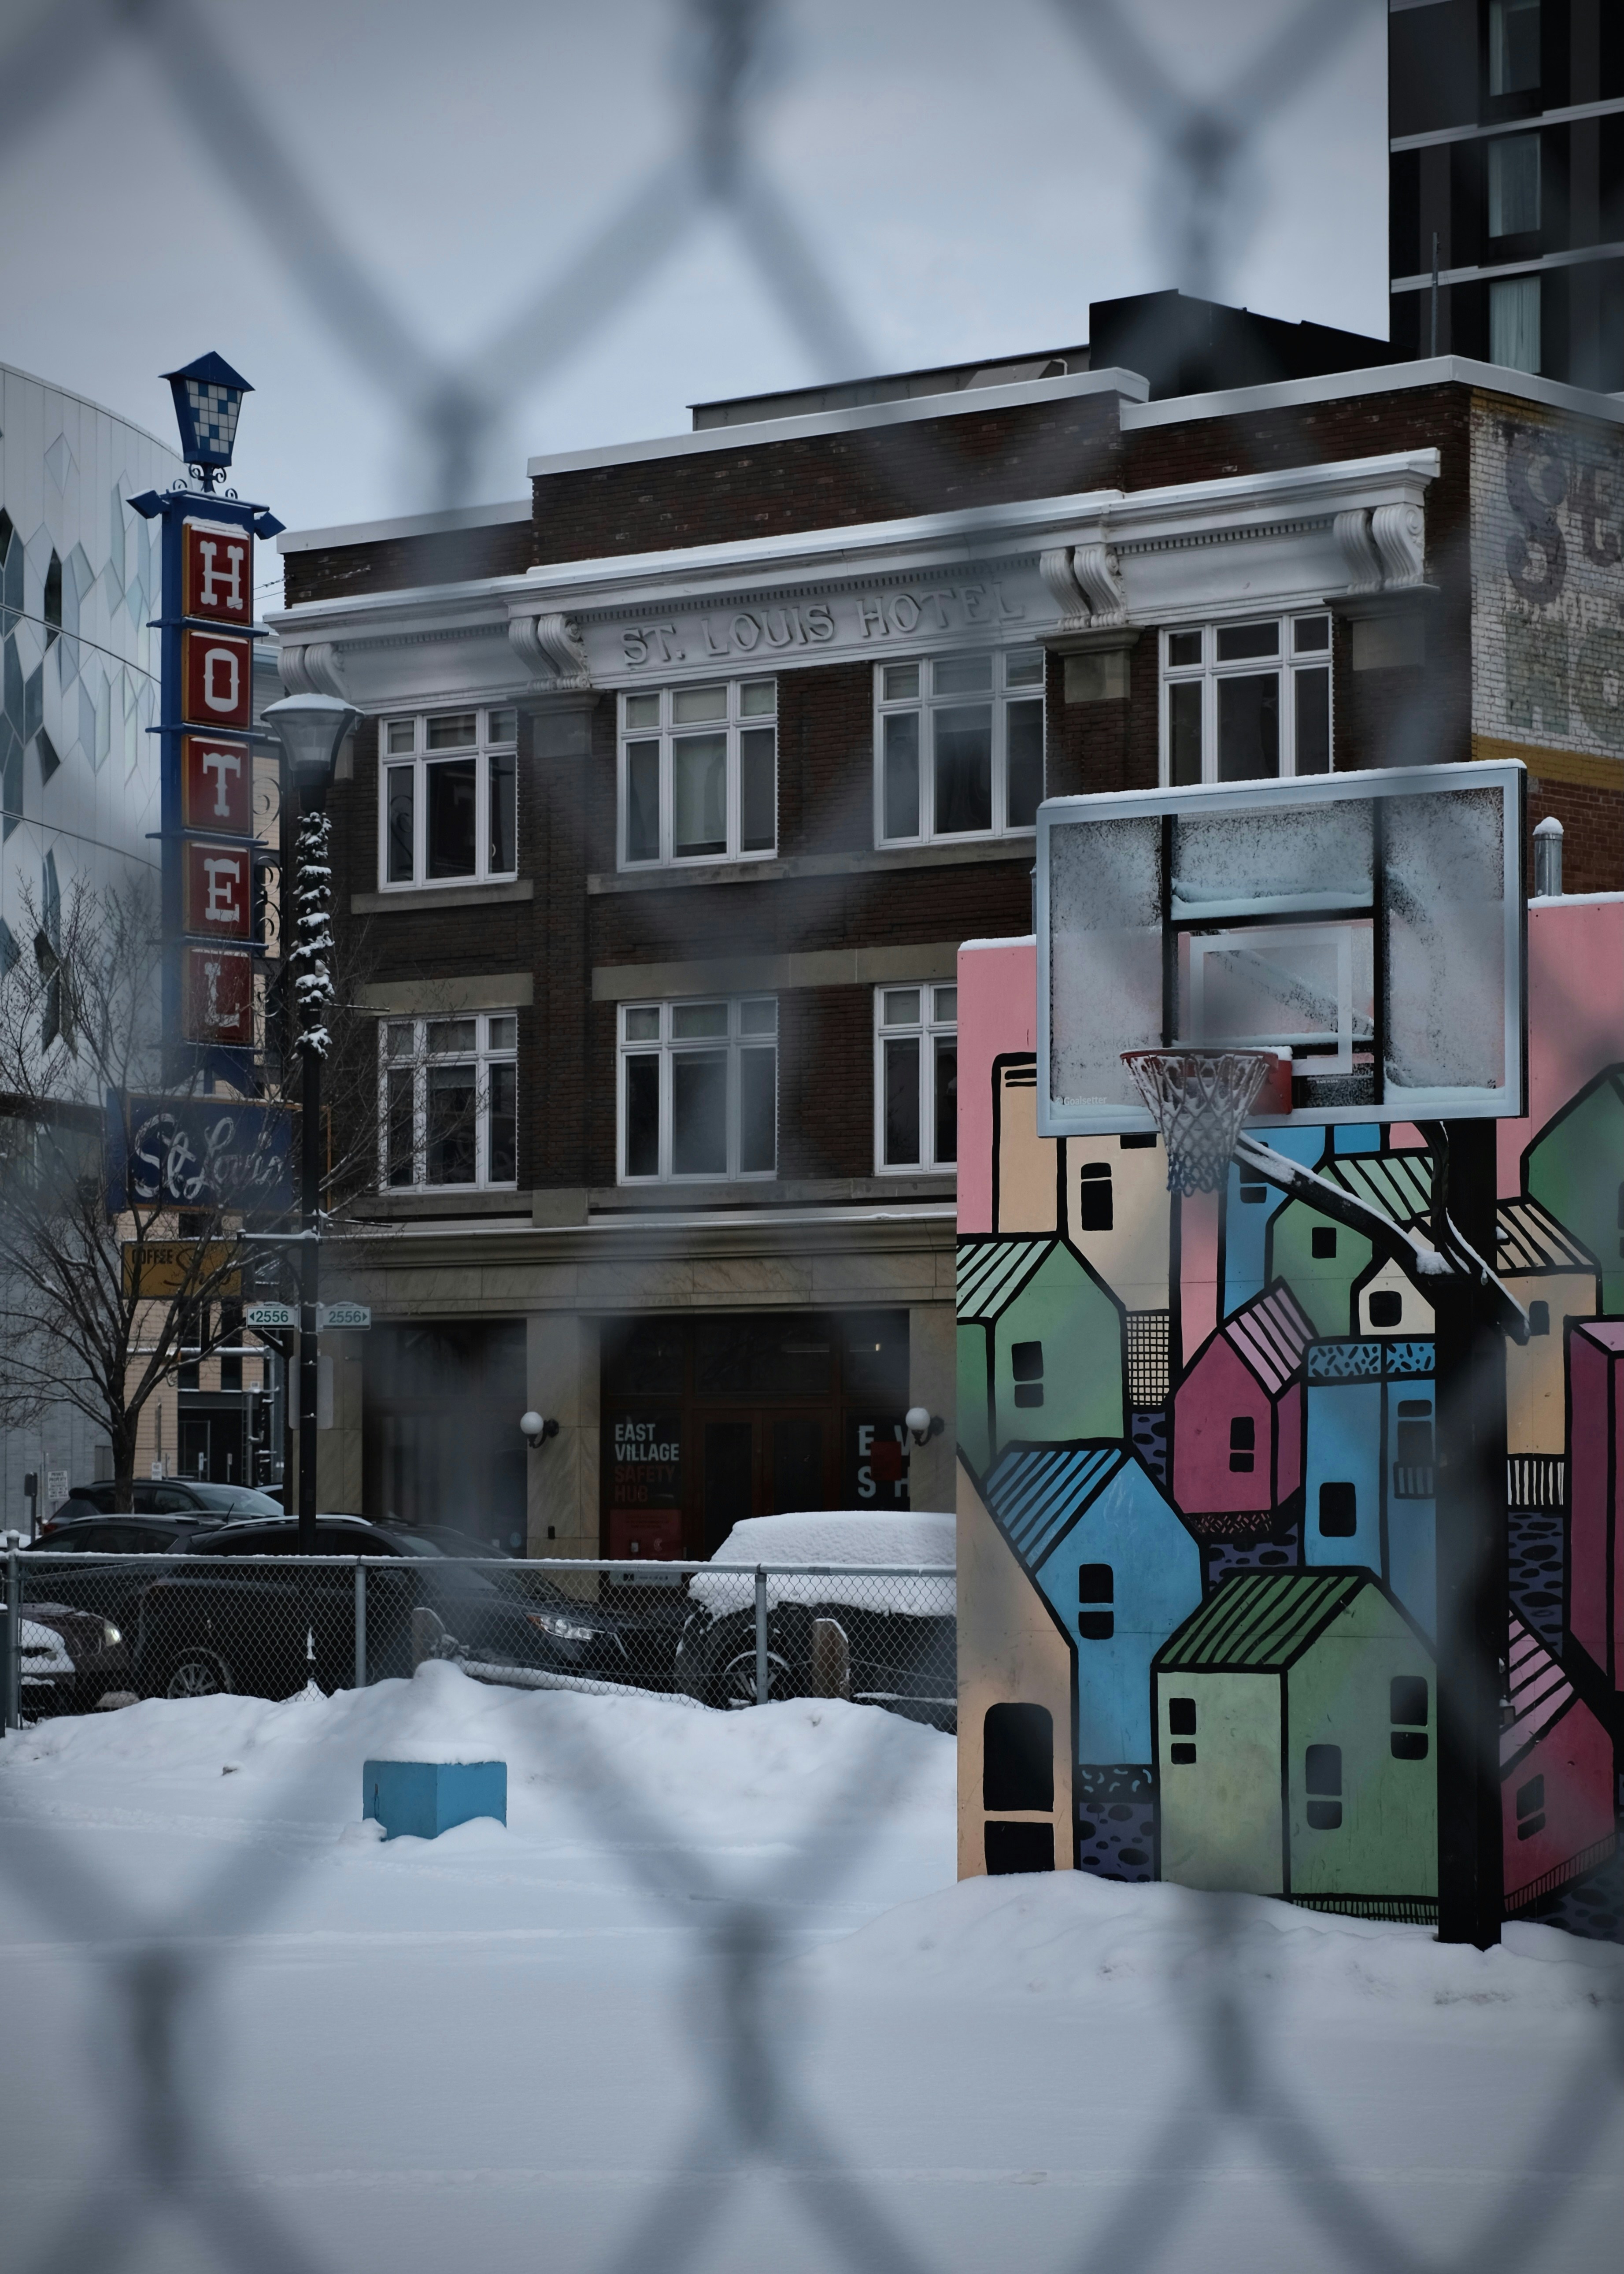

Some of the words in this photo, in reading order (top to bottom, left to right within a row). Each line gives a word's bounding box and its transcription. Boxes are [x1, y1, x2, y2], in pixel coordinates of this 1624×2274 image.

[621, 624, 685, 666] ST.
[702, 604, 835, 657] LOUIS
[855, 581, 1026, 638] HOTEL
[200, 541, 244, 1029] HOTEL
[1064, 1096, 1107, 1105] Goalsetter
[132, 1249, 173, 1264] COFFEE
[255, 1311, 289, 1323] 2556
[329, 1311, 361, 1323] 2556
[614, 1423, 656, 1441] EAST
[614, 1443, 680, 1461] VILLAGE
[614, 1465, 675, 1483] SAFETY
[614, 1485, 649, 1503] HUB
